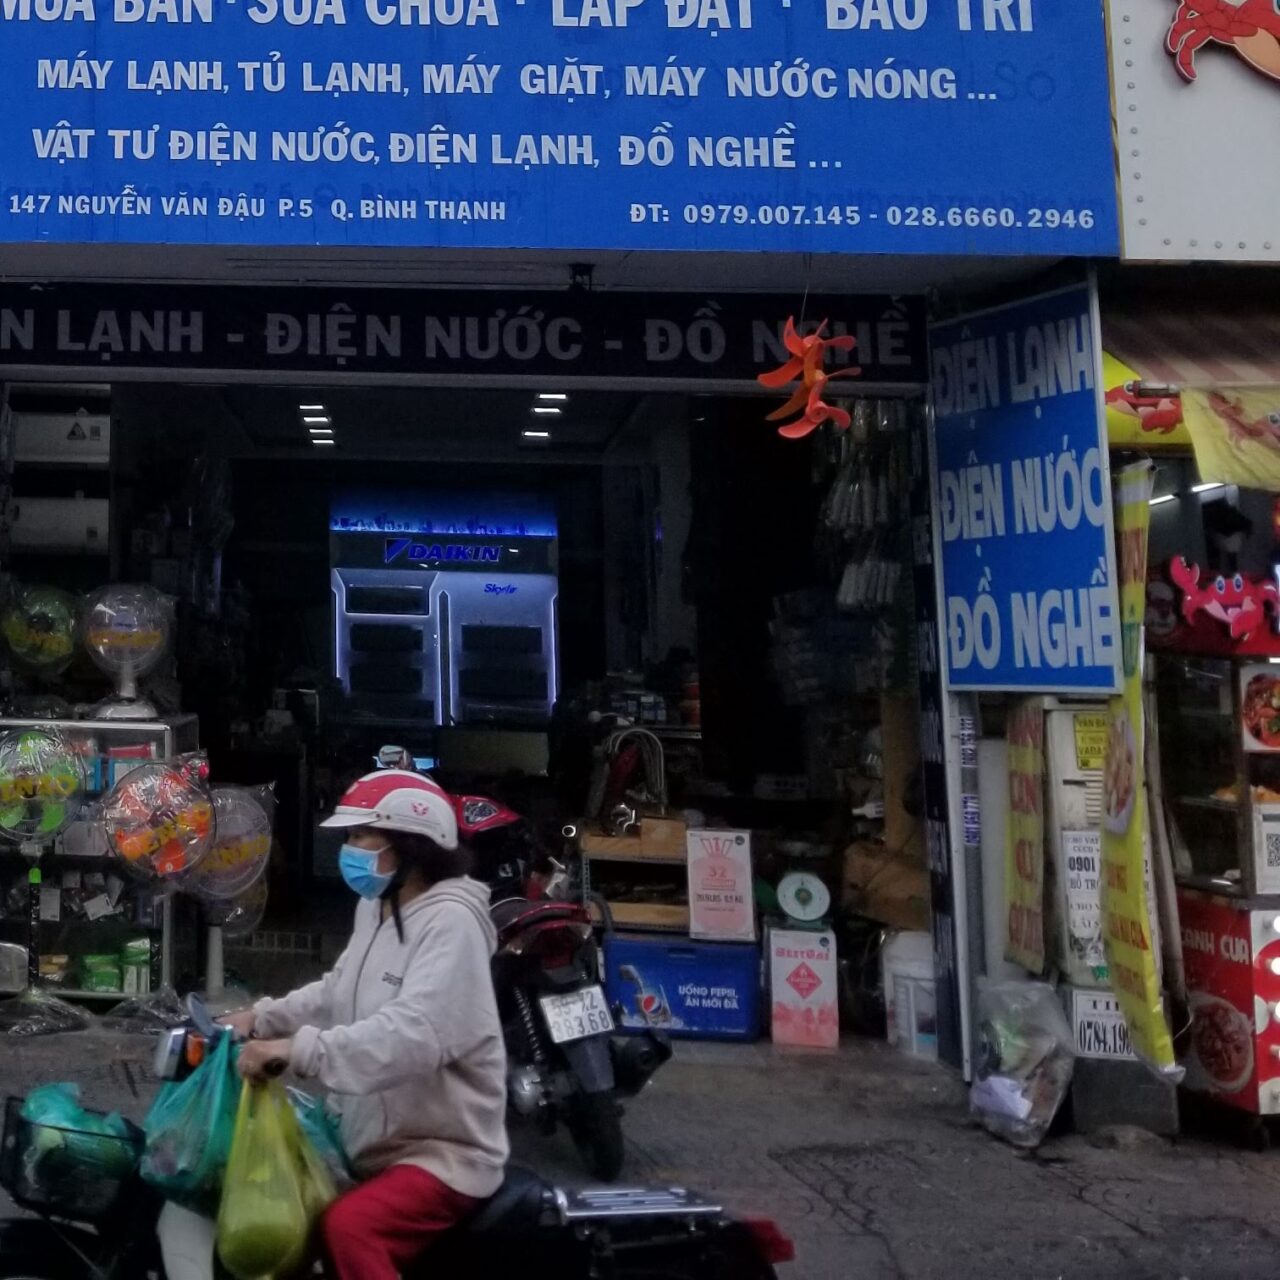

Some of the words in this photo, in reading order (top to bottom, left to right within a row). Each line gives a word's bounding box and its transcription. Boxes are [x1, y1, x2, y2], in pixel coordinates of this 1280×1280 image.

[36, 50, 113, 90] MÁY
[127, 60, 230, 96] LẠNH,
[237, 51, 286, 92] TỦ
[302, 61, 409, 98] LẠNH,
[422, 53, 501, 95] MÁY
[519, 57, 610, 103] GIẶT,
[624, 55, 706, 98] MÁY
[726, 57, 838, 99] NƯỚC
[848, 57, 957, 100] NÓNG
[32, 119, 95, 164] VẬT
[107, 124, 160, 161] TƯ
[168, 122, 257, 167] ĐIỆN
[271, 120, 380, 166] NƯỚC,
[388, 124, 477, 169] ĐIỆN
[491, 132, 600, 171] LẠNH,
[618, 121, 674, 167] ĐỒ
[687, 121, 797, 169] NGHỀ
[9, 194, 51, 214] 147
[58, 184, 152, 215] NGUYỄN
[161, 190, 208, 216] VĂN
[217, 192, 266, 222] ĐẬU
[360, 194, 417, 219] BÌNH
[424, 199, 506, 225] THẠNH
[629, 203, 670, 223] ĐT:
[683, 203, 862, 226] 0979.007.145
[886, 206, 1095, 230] 028.6660.2946
[57, 308, 204, 361] LẠNH
[263, 302, 403, 365] ĐIỆN
[424, 305, 583, 362] NƯỚC
[643, 300, 726, 364] ĐỒ
[753, 295, 912, 366] NHỀ
[932, 324, 1001, 430] ĐIỆN
[1006, 313, 1095, 419] LẠNH
[939, 449, 1006, 558] ĐIỆN
[1010, 434, 1106, 536] NƯỚC
[407, 544, 502, 562] DAIKIN
[947, 566, 1001, 671] ĐỒ
[1010, 556, 1115, 671] NGHỀ
